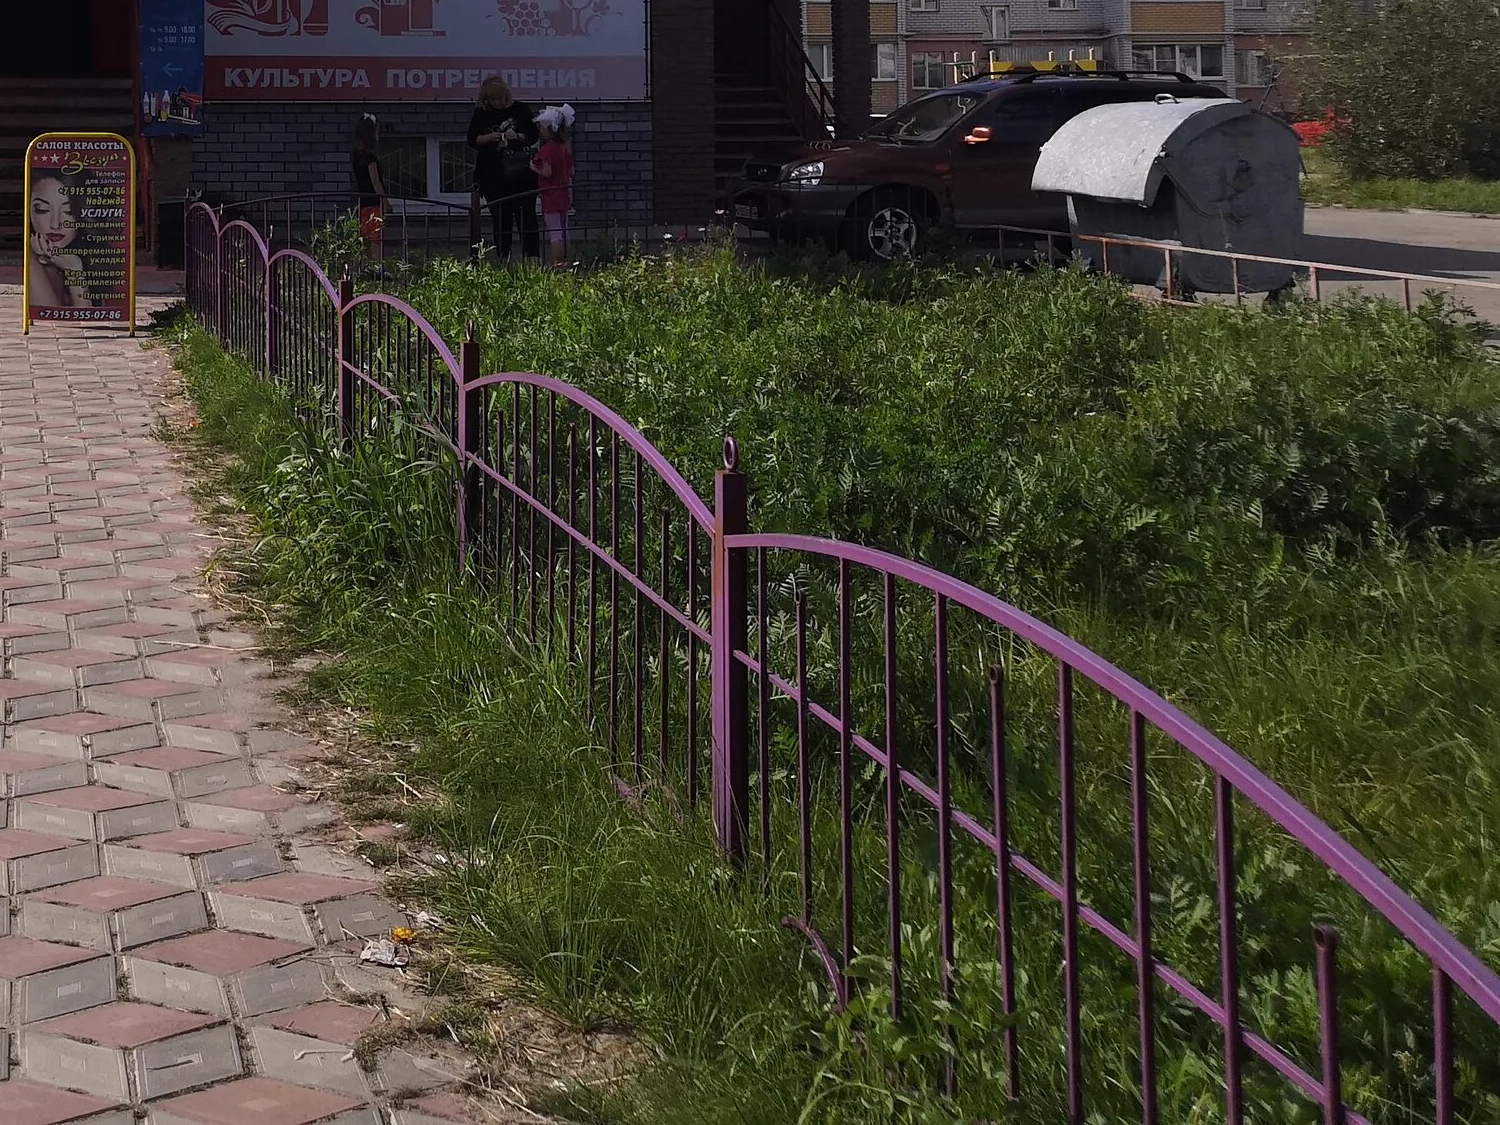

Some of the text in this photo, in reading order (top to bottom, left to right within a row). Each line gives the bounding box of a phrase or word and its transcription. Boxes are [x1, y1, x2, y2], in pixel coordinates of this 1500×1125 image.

[224, 68, 370, 89] КУЛЬТУРА
[36, 142, 124, 150] САЛОН КРАСОТЫ
[69, 187, 85, 195] 915
[86, 187, 125, 195] 955-07-86
[86, 197, 125, 205] Надежда
[80, 209, 125, 218] УСЛУГИ:
[63, 221, 125, 230] Окрашивание
[86, 235, 125, 243] Стрижки
[51, 248, 125, 256] Долговременная
[64, 270, 125, 278] Кератиновое
[64, 280, 125, 288] выпрямление
[39, 310, 51, 318] +7
[73, 311, 121, 319] 955-07-86
